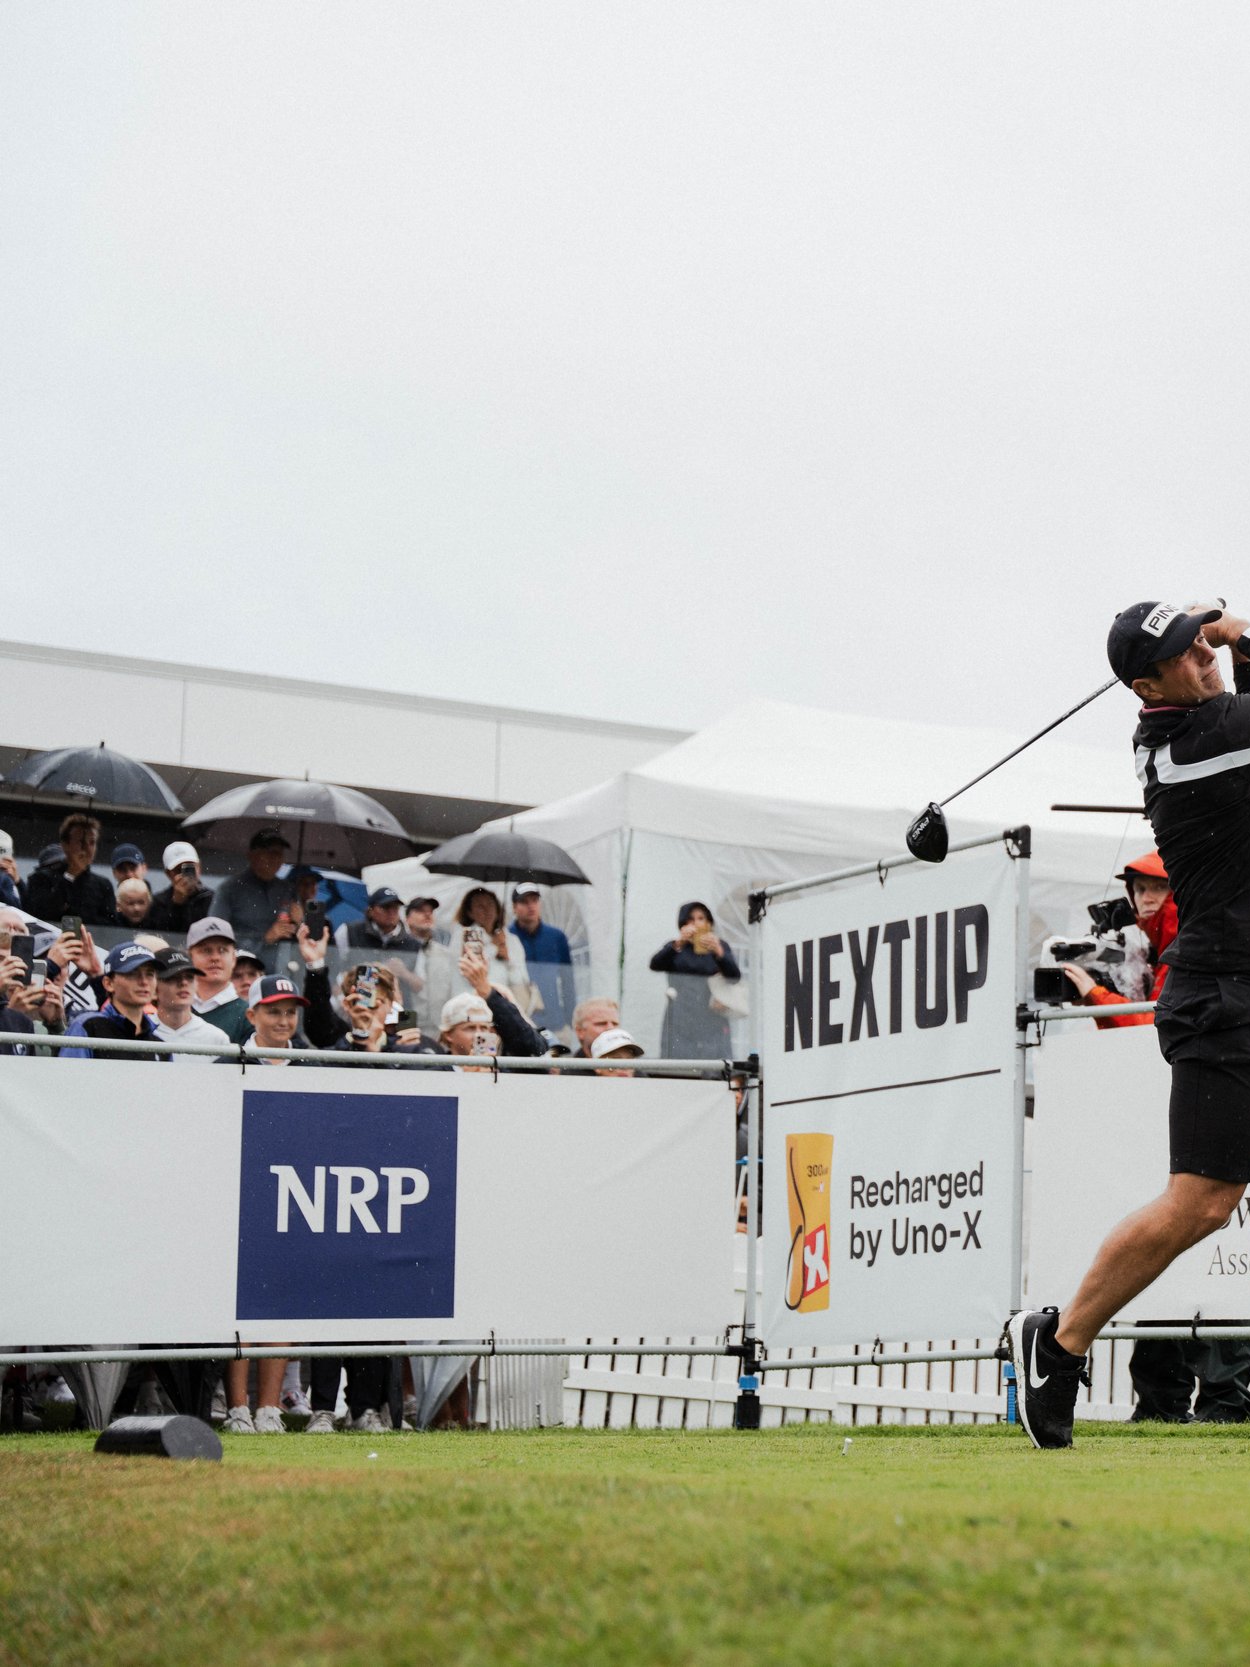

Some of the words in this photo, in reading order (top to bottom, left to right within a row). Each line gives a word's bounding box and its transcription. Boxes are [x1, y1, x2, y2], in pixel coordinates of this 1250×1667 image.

[1148, 605, 1179, 631] PIN
[784, 903, 989, 1052] NEXTUP
[270, 1165, 430, 1233] NRP
[850, 1161, 983, 1209] Recharged
[850, 1222, 882, 1267] by
[892, 1210, 982, 1256] Uno-X
